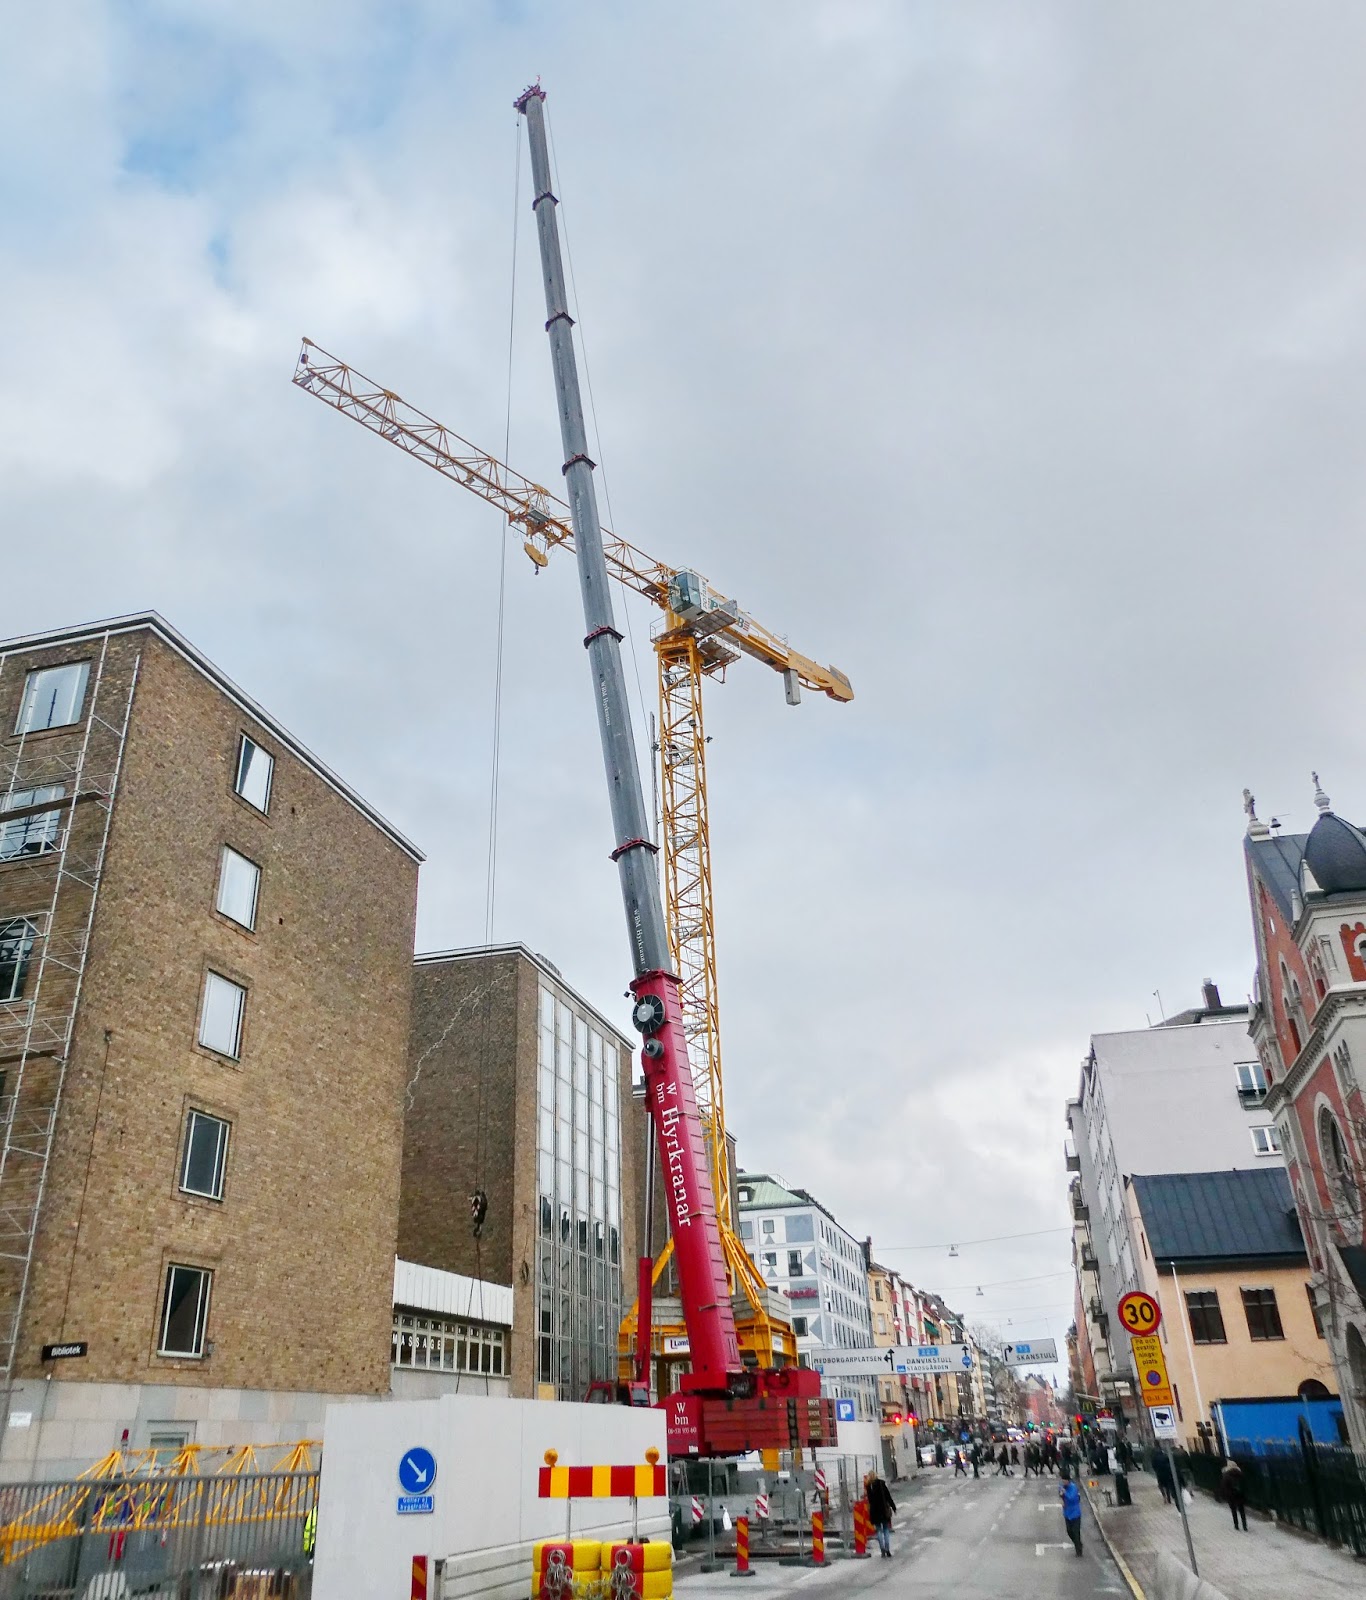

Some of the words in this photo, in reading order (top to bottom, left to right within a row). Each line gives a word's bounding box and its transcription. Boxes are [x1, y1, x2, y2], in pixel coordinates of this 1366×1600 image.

[655, 1082, 665, 1104] bm
[666, 1081, 678, 1096] W
[662, 1104, 691, 1227] Hyrkranar
[1125, 1302, 1155, 1325] 30
[392, 1333, 441, 1350] MASSAGE
[51, 1346, 81, 1357] Bibliotek
[1016, 1353, 1056, 1361] SKANSTULL
[813, 1356, 882, 1364] MEDBORGARPLATSEN
[676, 1402, 686, 1414] W
[840, 1404, 852, 1418] P
[674, 1414, 689, 1425] bm
